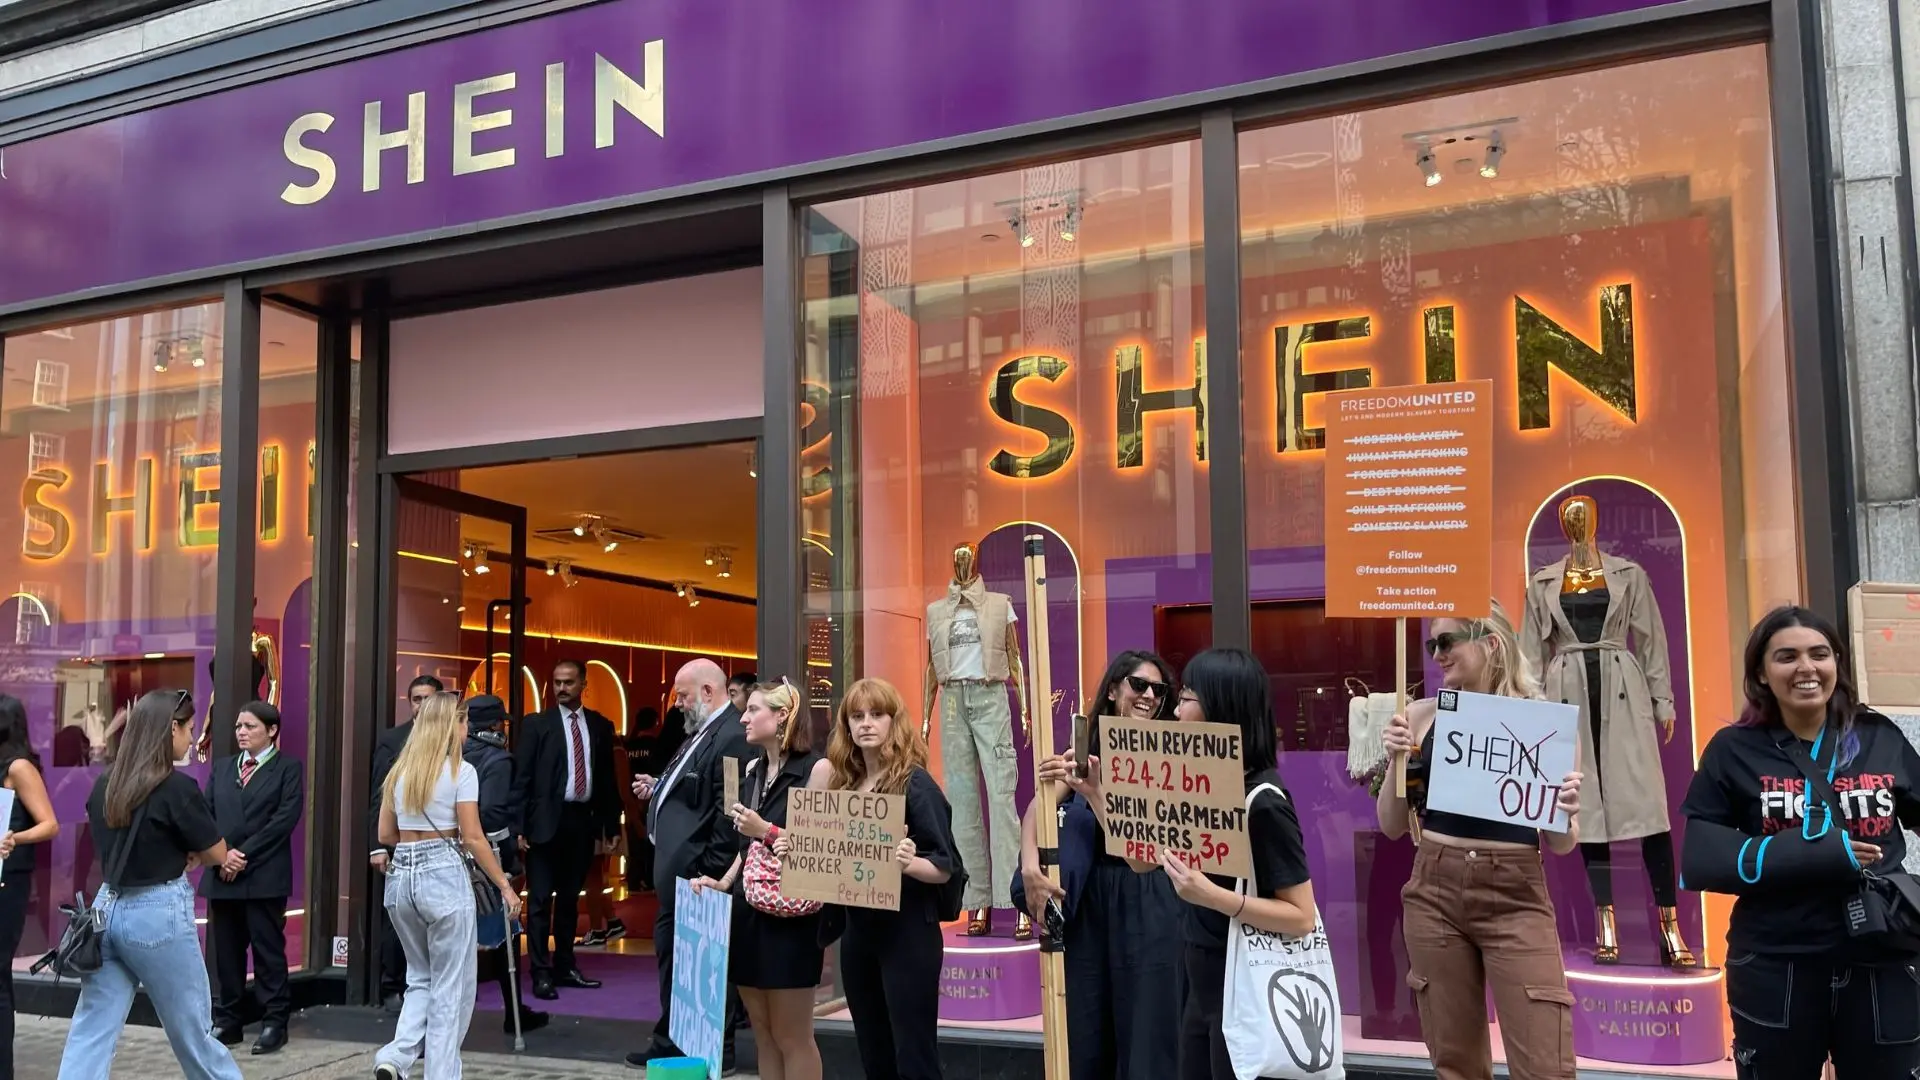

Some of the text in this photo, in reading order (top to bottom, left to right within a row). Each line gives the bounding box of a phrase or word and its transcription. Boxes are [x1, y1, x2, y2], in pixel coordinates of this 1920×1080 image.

[280, 39, 664, 205] SHEIN
[987, 283, 1638, 477] SHEIN
[1341, 391, 1476, 412] FREEDOMUNITED
[1376, 411, 1404, 419] MODERN
[1406, 409, 1437, 417] SLAVERY
[1439, 407, 1476, 415] TOGETHER
[1354, 430, 1458, 445] MODERN SLAVERY
[1348, 447, 1468, 462] HUMAN TRAFFICKING
[1353, 466, 1463, 479] FORCED MARRIAGE
[1363, 484, 1451, 497] DEBT BONDAGE
[22, 445, 315, 559] SHEI
[1352, 502, 1465, 515] CHILD TRAFFICKING
[1354, 519, 1467, 532] DOMESTIC SLAVERY
[1388, 550, 1423, 560] Follow
[1356, 564, 1457, 576] @freedomunitedHQ
[1376, 586, 1437, 596] Take action
[1359, 601, 1455, 612] freedomunited.org
[1441, 692, 1456, 701] END
[1108, 727, 1239, 760] SHEIN REVENUE
[1444, 730, 1540, 778] SHEIN
[1111, 756, 1211, 795] £24.2 bn
[1760, 772, 1895, 793] THIS SHIRT
[793, 789, 889, 820] SHEIN CEO
[1500, 778, 1562, 824] OUT
[1105, 792, 1246, 832] SHEIN GARMENT
[793, 815, 810, 828] Net
[814, 817, 845, 831] worth
[788, 833, 894, 862] SHEIN GARMENT
[1106, 818, 1230, 866] WORKERS 3p
[1126, 841, 1157, 863] PER
[787, 855, 842, 875] WORKER
[838, 883, 895, 907] Per item
[1847, 898, 1867, 930] JBL
[1248, 937, 1328, 955] MY STUFF
[674, 936, 693, 991] FOR
[938, 985, 991, 999] ASHION
[1582, 998, 1694, 1014] ON DEMAND
[1599, 1021, 1681, 1037] FASHION
